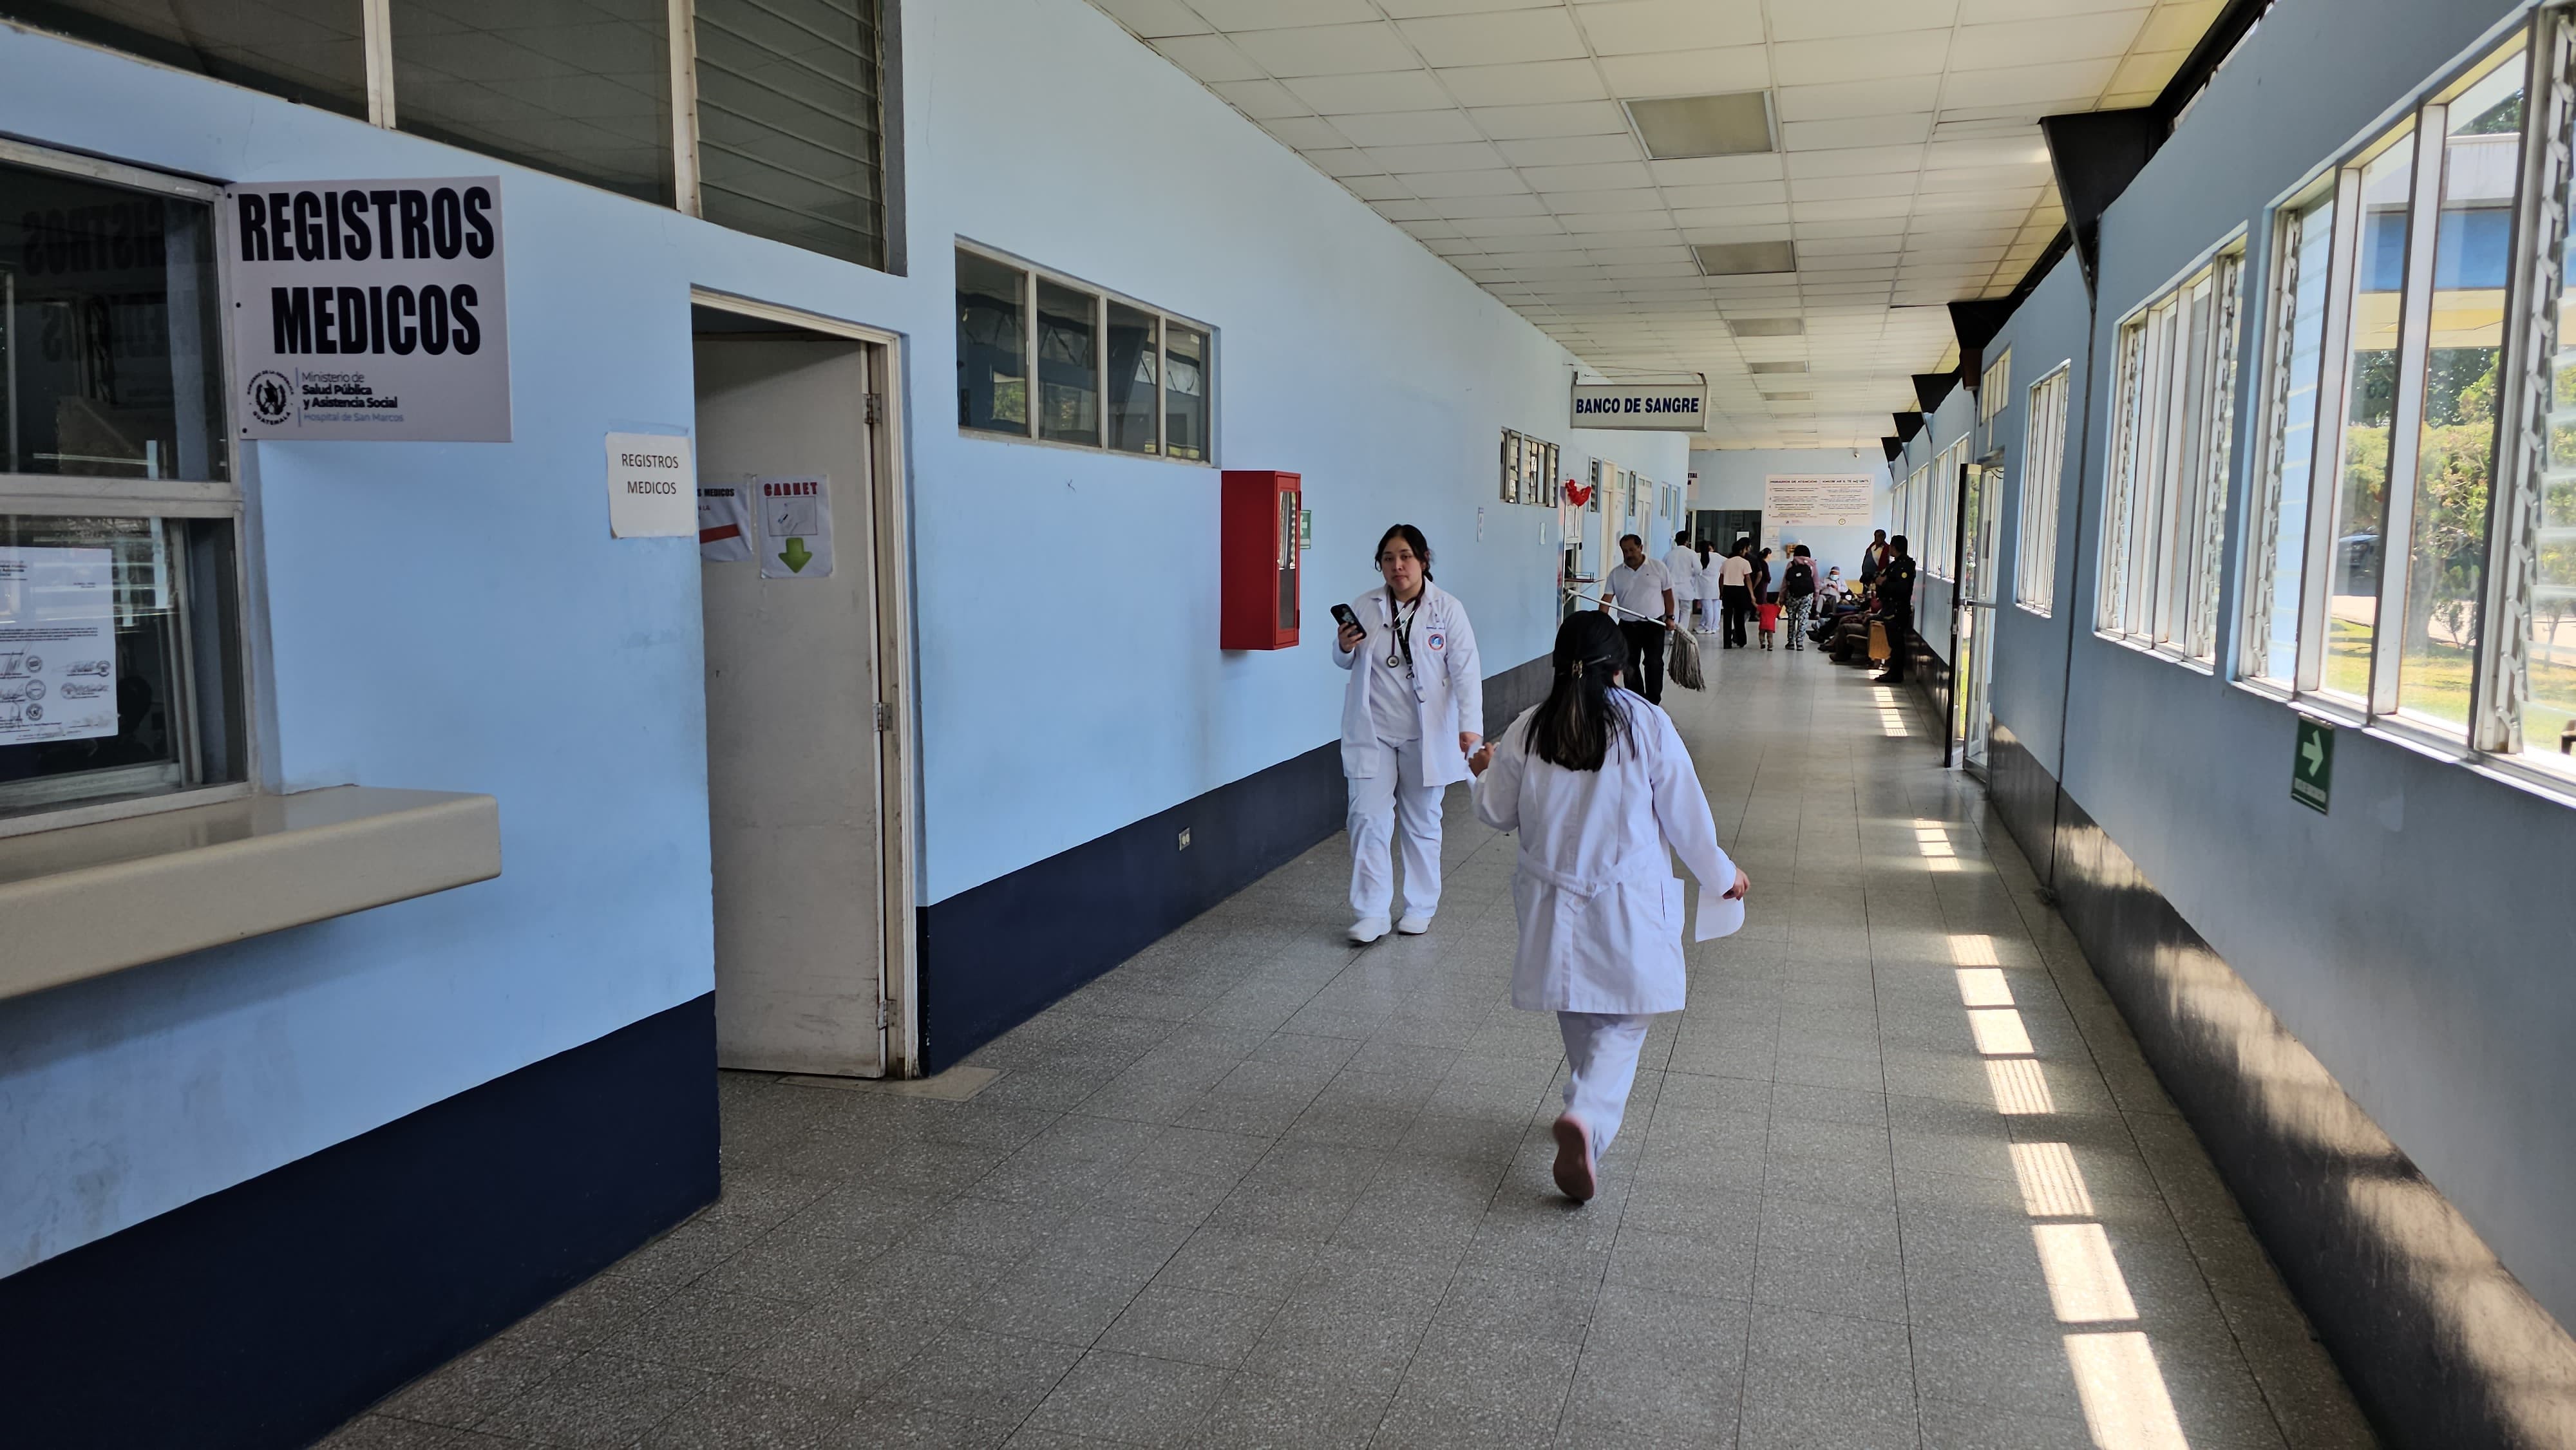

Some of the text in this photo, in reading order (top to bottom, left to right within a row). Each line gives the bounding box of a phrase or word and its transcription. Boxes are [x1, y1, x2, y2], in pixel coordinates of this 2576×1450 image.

[238, 187, 495, 261] REGISTROS
[271, 284, 480, 355] MEDICOS
[302, 372, 365, 382] Ministerio de
[303, 383, 372, 395] Salud Pública
[303, 397, 397, 410] y Asistencia Social
[1576, 397, 1699, 413] BANCO DE SANGRE
[304, 412, 339, 422] Hospital
[621, 453, 679, 468] REGISTROS
[627, 481, 676, 494] MEDICOS
